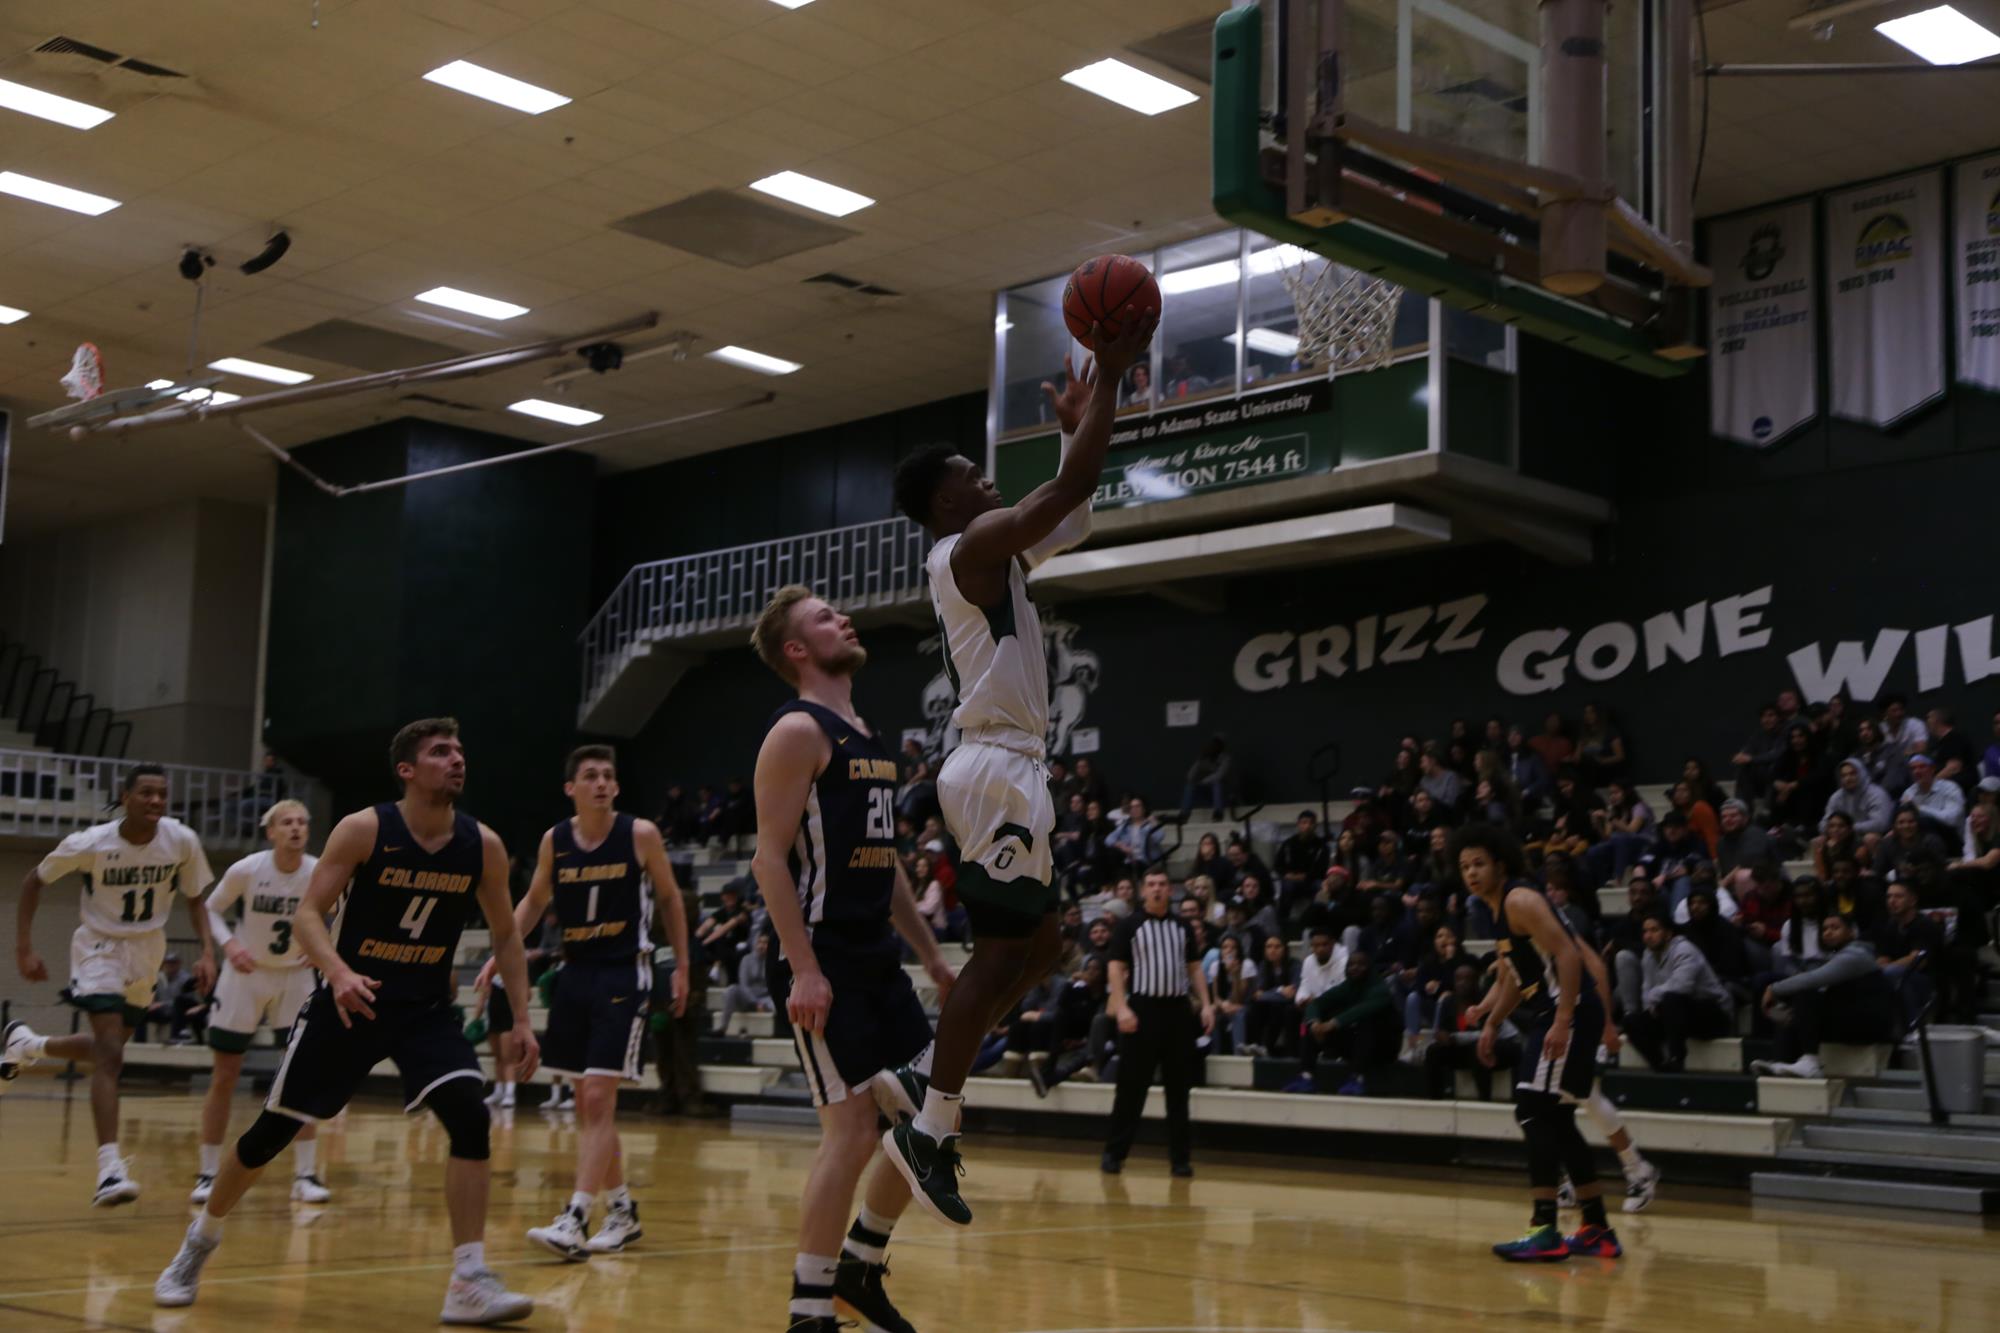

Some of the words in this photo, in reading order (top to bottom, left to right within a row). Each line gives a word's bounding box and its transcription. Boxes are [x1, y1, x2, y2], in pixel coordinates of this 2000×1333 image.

[1109, 429, 1139, 446] come
[1142, 424, 1157, 439] to
[1158, 414, 1201, 436] Adams
[1204, 408, 1237, 425] State
[1241, 392, 1313, 418] University
[1094, 464, 1217, 502] ELEVTION
[1223, 453, 1276, 482] 7544
[1282, 449, 1301, 471] ft
[1171, 449, 1188, 467] of
[1232, 592, 1490, 693] GRIZZ
[1495, 584, 1774, 696] GONE
[1785, 613, 2000, 704] WIL
[865, 786, 895, 840] 20
[102, 867, 140, 886] ADAMS
[377, 866, 473, 894] COLORADO
[121, 889, 154, 922] 11
[399, 895, 440, 940] 4
[586, 885, 600, 922] 1
[268, 920, 292, 955] 3
